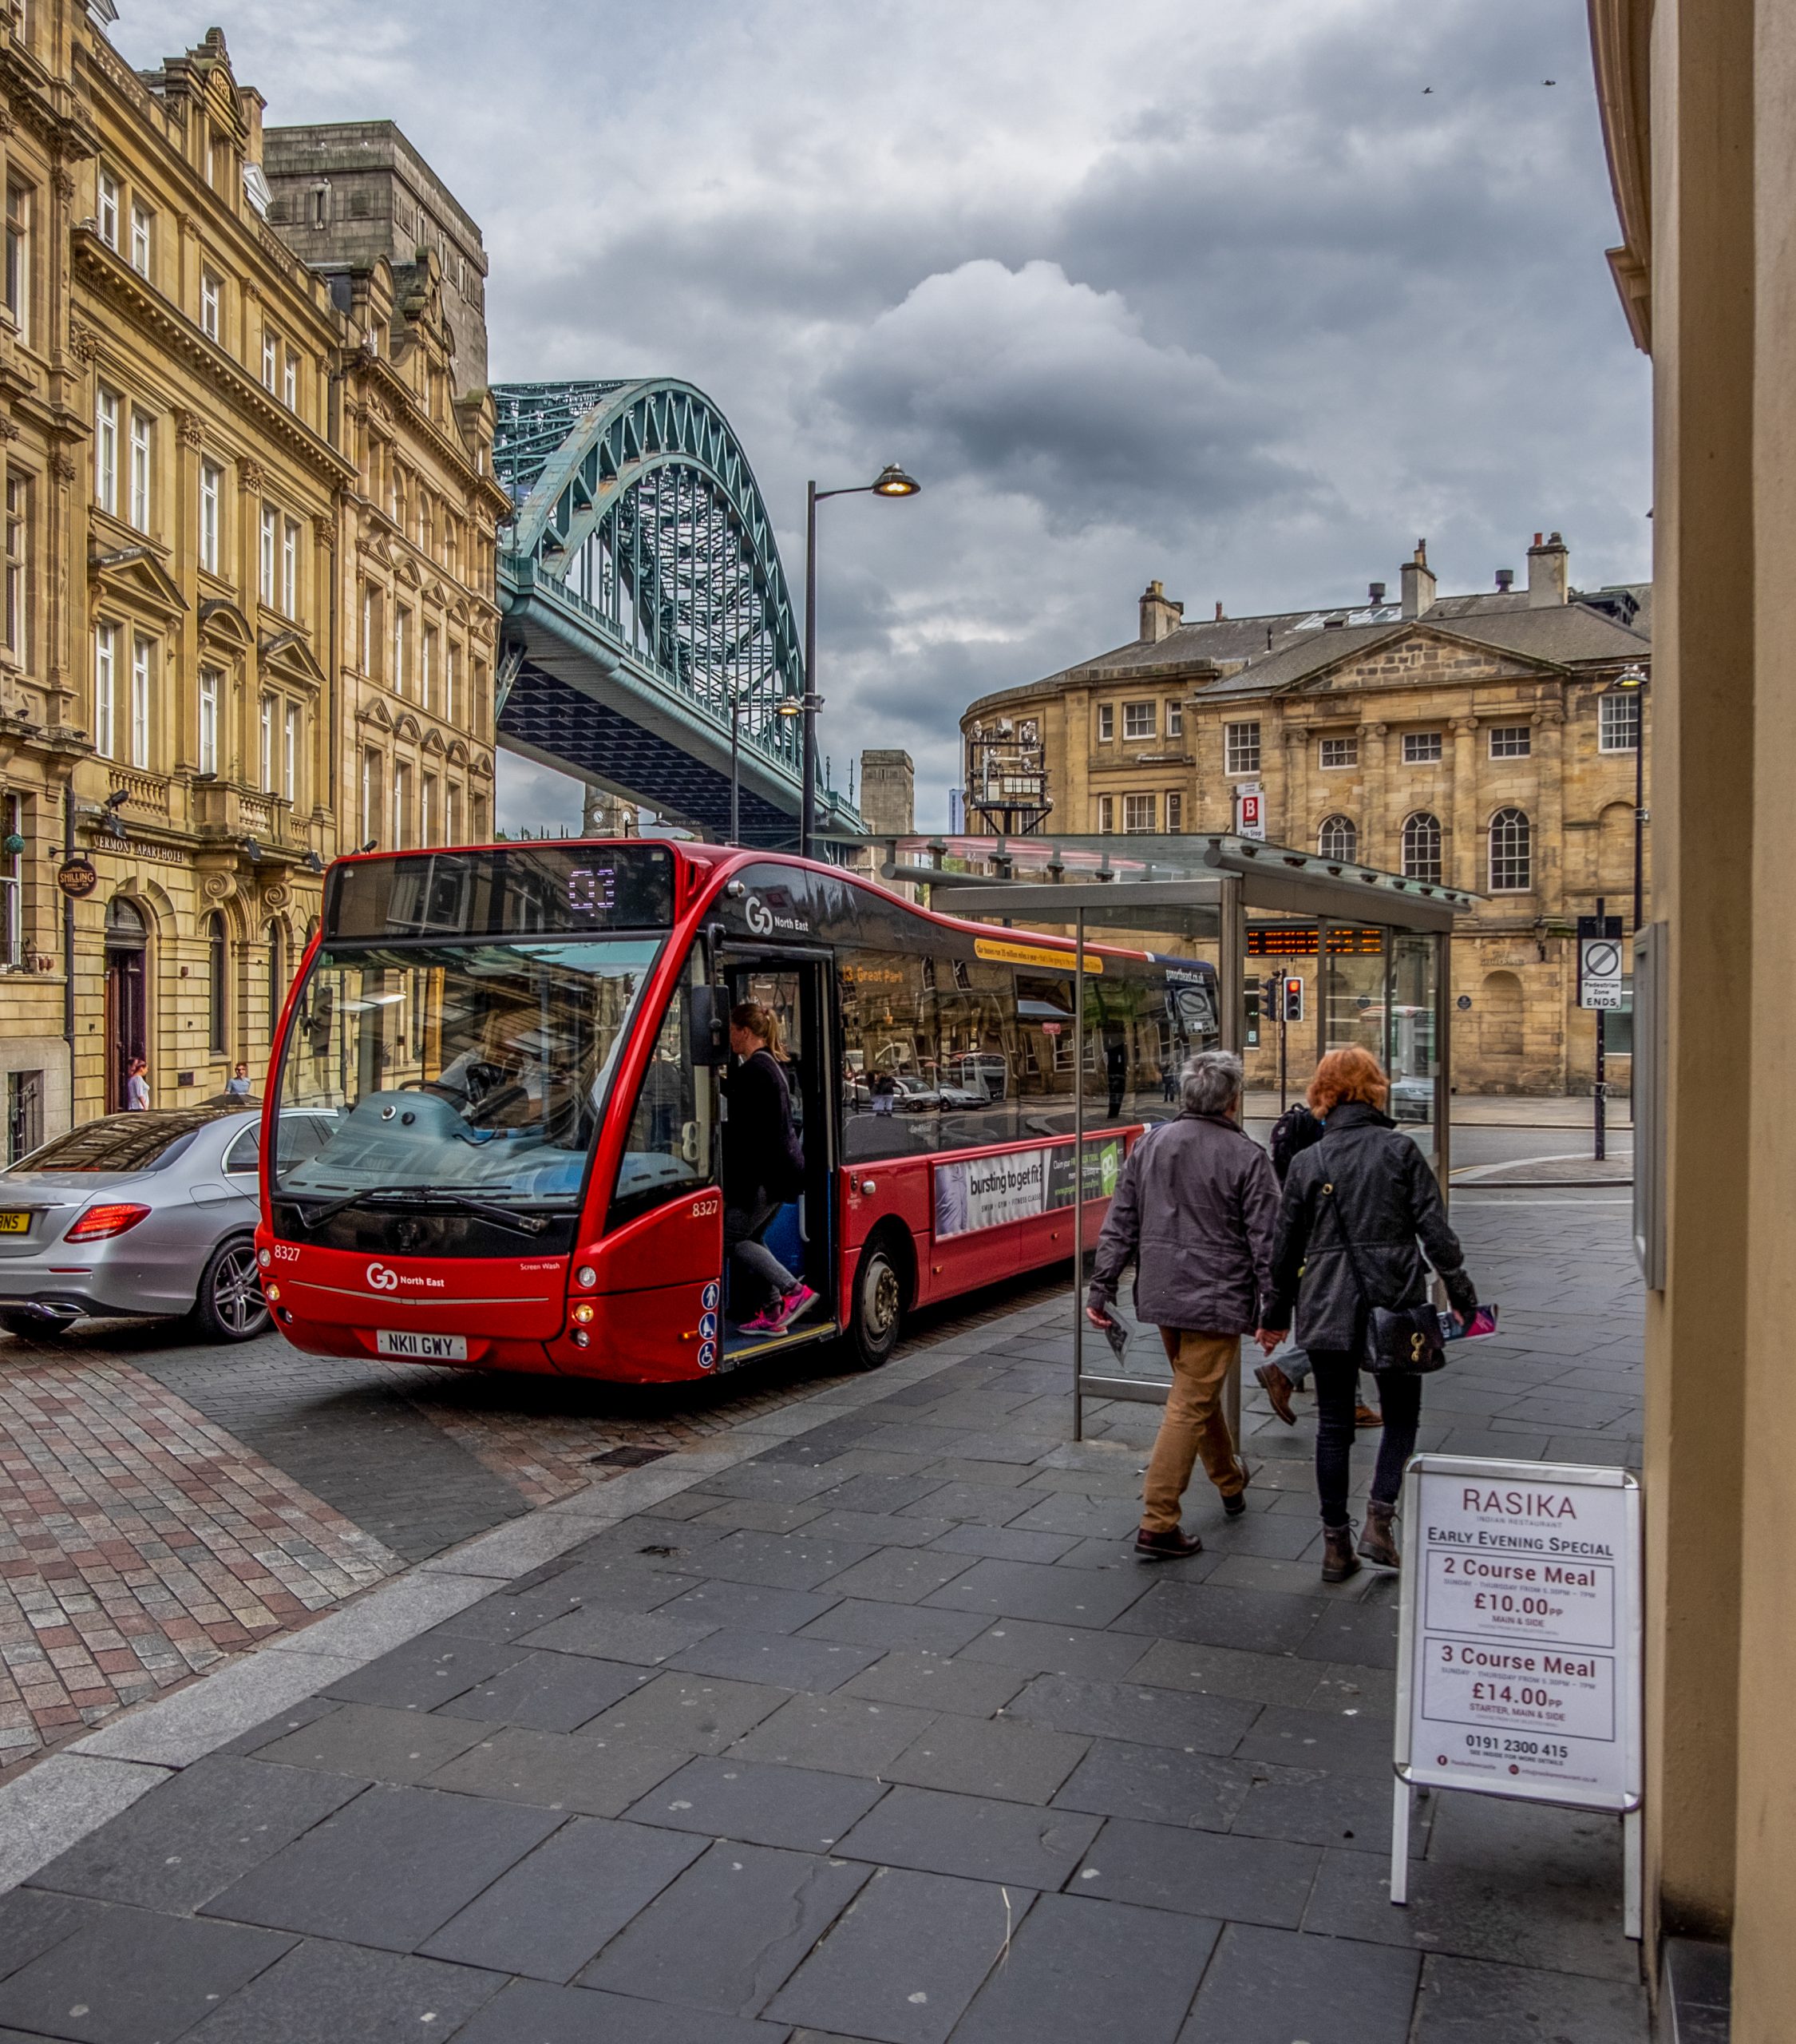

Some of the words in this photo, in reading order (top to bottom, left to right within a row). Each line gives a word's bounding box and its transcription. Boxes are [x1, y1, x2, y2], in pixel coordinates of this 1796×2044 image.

[1245, 799, 1256, 817] B
[93, 834, 134, 855] VERMONT
[60, 873, 94, 883] SHILLING
[774, 916, 793, 929] North
[795, 918, 809, 932] East
[857, 966, 882, 983] Great
[884, 969, 903, 984] Park
[971, 1171, 1006, 1195] bursting
[1007, 1171, 1016, 1188] to
[1017, 1167, 1031, 1190] get
[692, 1200, 718, 1217] 8327
[981, 1203, 993, 1213] SWIM
[998, 1200, 1007, 1209] GYM
[1011, 1196, 1027, 1206] FITNESS
[274, 1245, 300, 1262] 8327
[542, 1262, 560, 1270] Wash
[400, 1275, 424, 1286] North
[426, 1278, 445, 1288] East
[389, 1333, 417, 1353] NK11
[422, 1337, 453, 1356] GWY
[1462, 1488, 1577, 1519] RASIKA
[1477, 1515, 1506, 1524] INDIAN
[1508, 1518, 1562, 1529] RESTAURANT
[1443, 1558, 1455, 1574] 2
[1463, 1559, 1536, 1581] Course
[1545, 1567, 1596, 1586] Meal
[1480, 1582, 1517, 1590] THURSDAY
[1492, 1615, 1515, 1624] MAIN
[1525, 1618, 1545, 1627] SIDE
[1442, 1646, 1453, 1662] 3
[1462, 1647, 1536, 1671] Course
[1544, 1656, 1596, 1678] Meal
[1478, 1670, 1517, 1680] THURSDAY
[1512, 1708, 1535, 1717] MAIN
[1545, 1712, 1566, 1721] SIDE
[1466, 1734, 1498, 1749] 0191
[1504, 1739, 1537, 1754] 2300
[1541, 1744, 1569, 1758] 415
[1537, 1757, 1564, 1766] DETAILS
